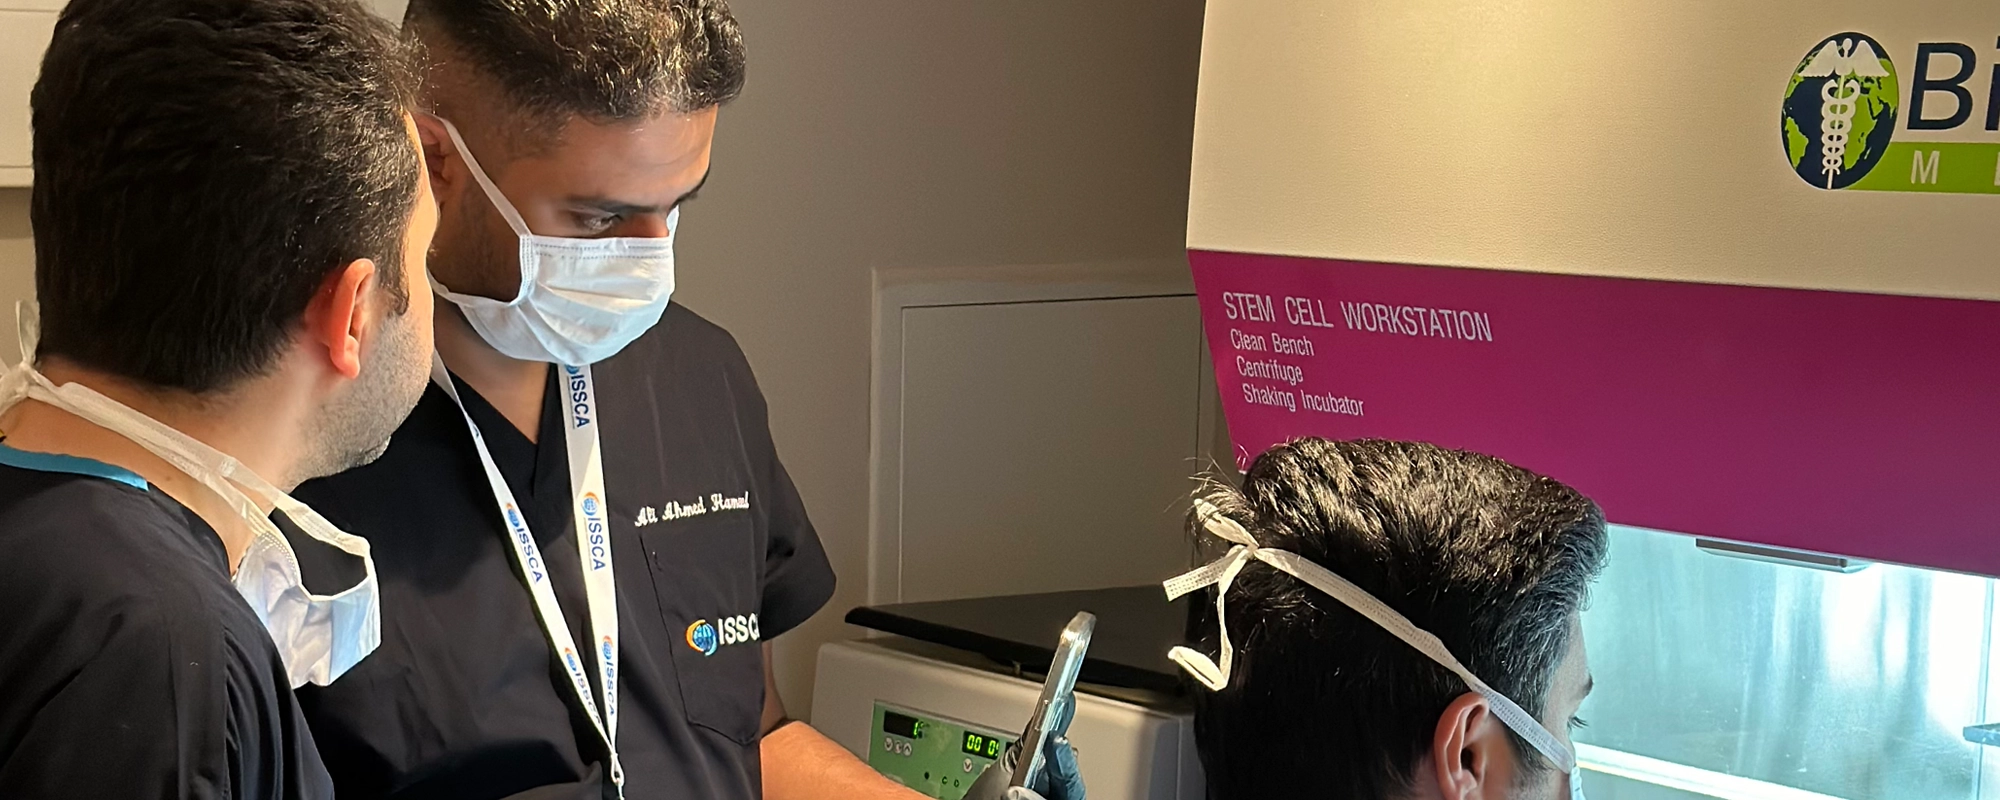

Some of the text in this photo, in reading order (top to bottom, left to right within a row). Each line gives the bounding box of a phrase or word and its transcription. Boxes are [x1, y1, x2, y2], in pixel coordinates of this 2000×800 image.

[1223, 292, 1493, 342] STEM CELL WORKSTATION
[1230, 329, 1314, 356] Clean Bench
[1236, 355, 1304, 386] Centrifuge
[571, 374, 590, 427] ISSCA
[1242, 383, 1364, 417] Shaking Incubator
[662, 496, 707, 520] Ahmed
[516, 528, 543, 583] ISSCA
[588, 517, 606, 570] ISSCA
